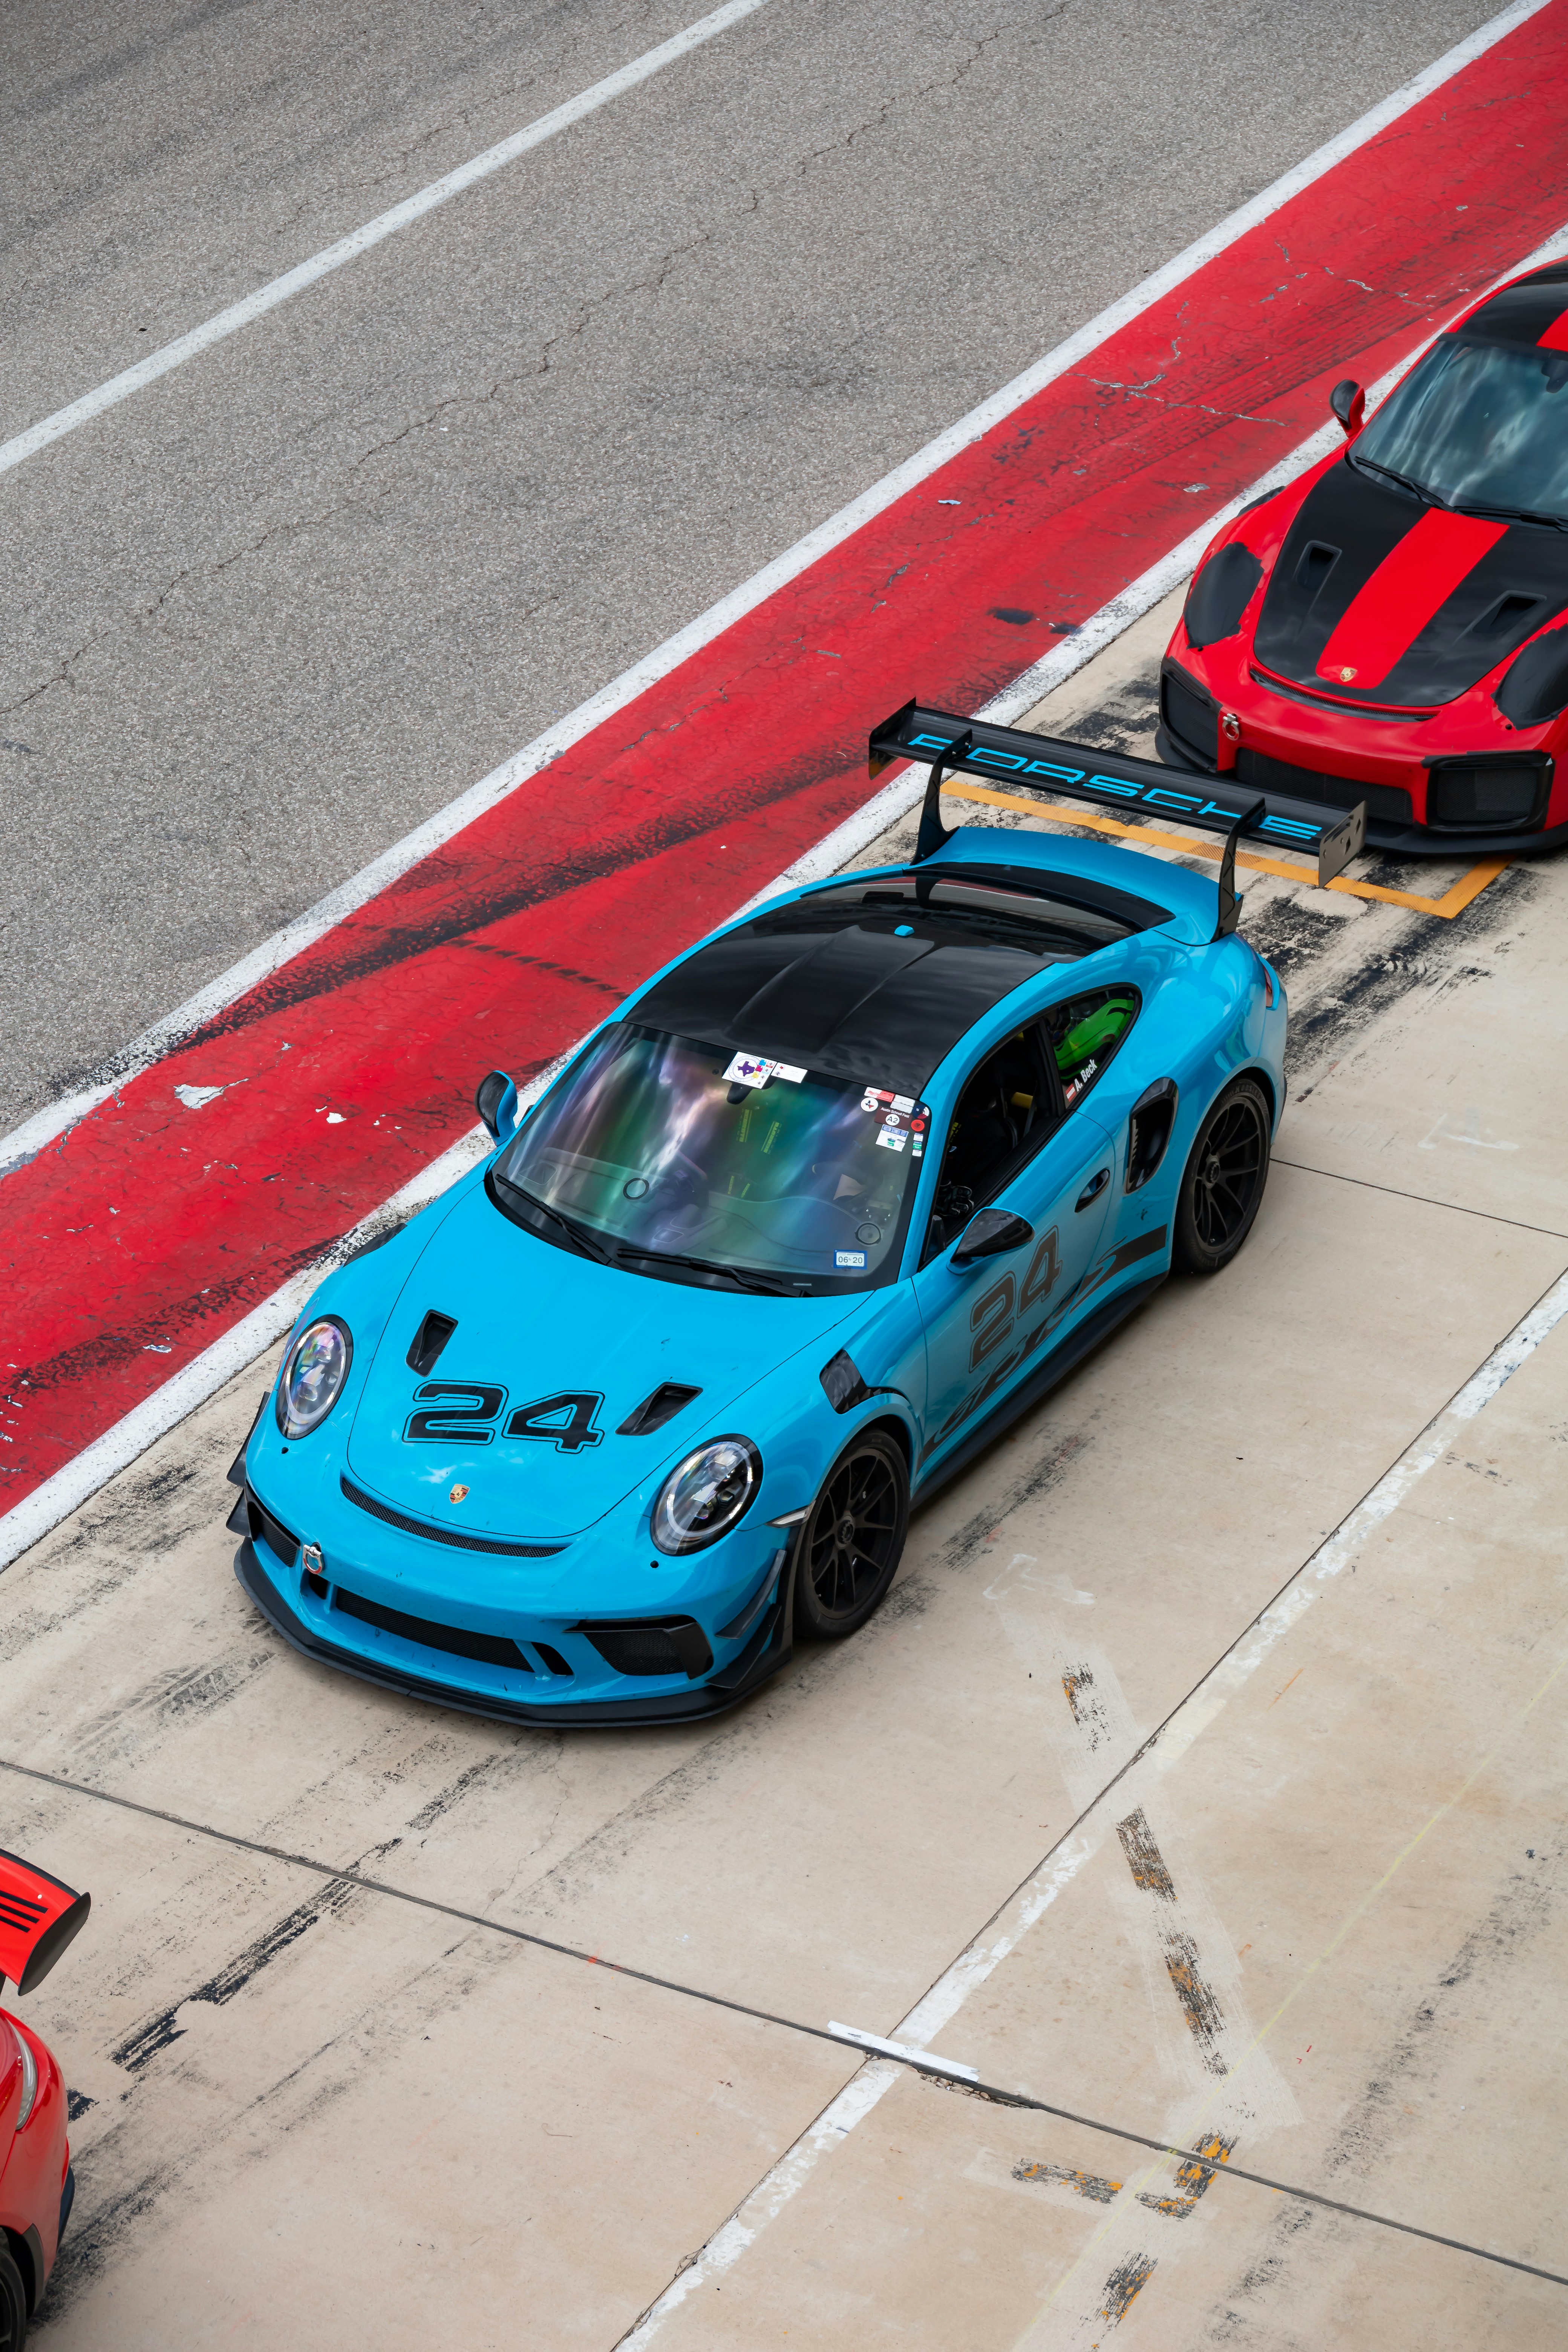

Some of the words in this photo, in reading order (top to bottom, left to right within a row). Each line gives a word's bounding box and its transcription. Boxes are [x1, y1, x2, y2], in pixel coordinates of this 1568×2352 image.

[1074, 1078, 1083, 1092] A.
[1081, 1059, 1097, 1083] Beck
[969, 1225, 1063, 1374] 24
[401, 1379, 605, 1455] 24
